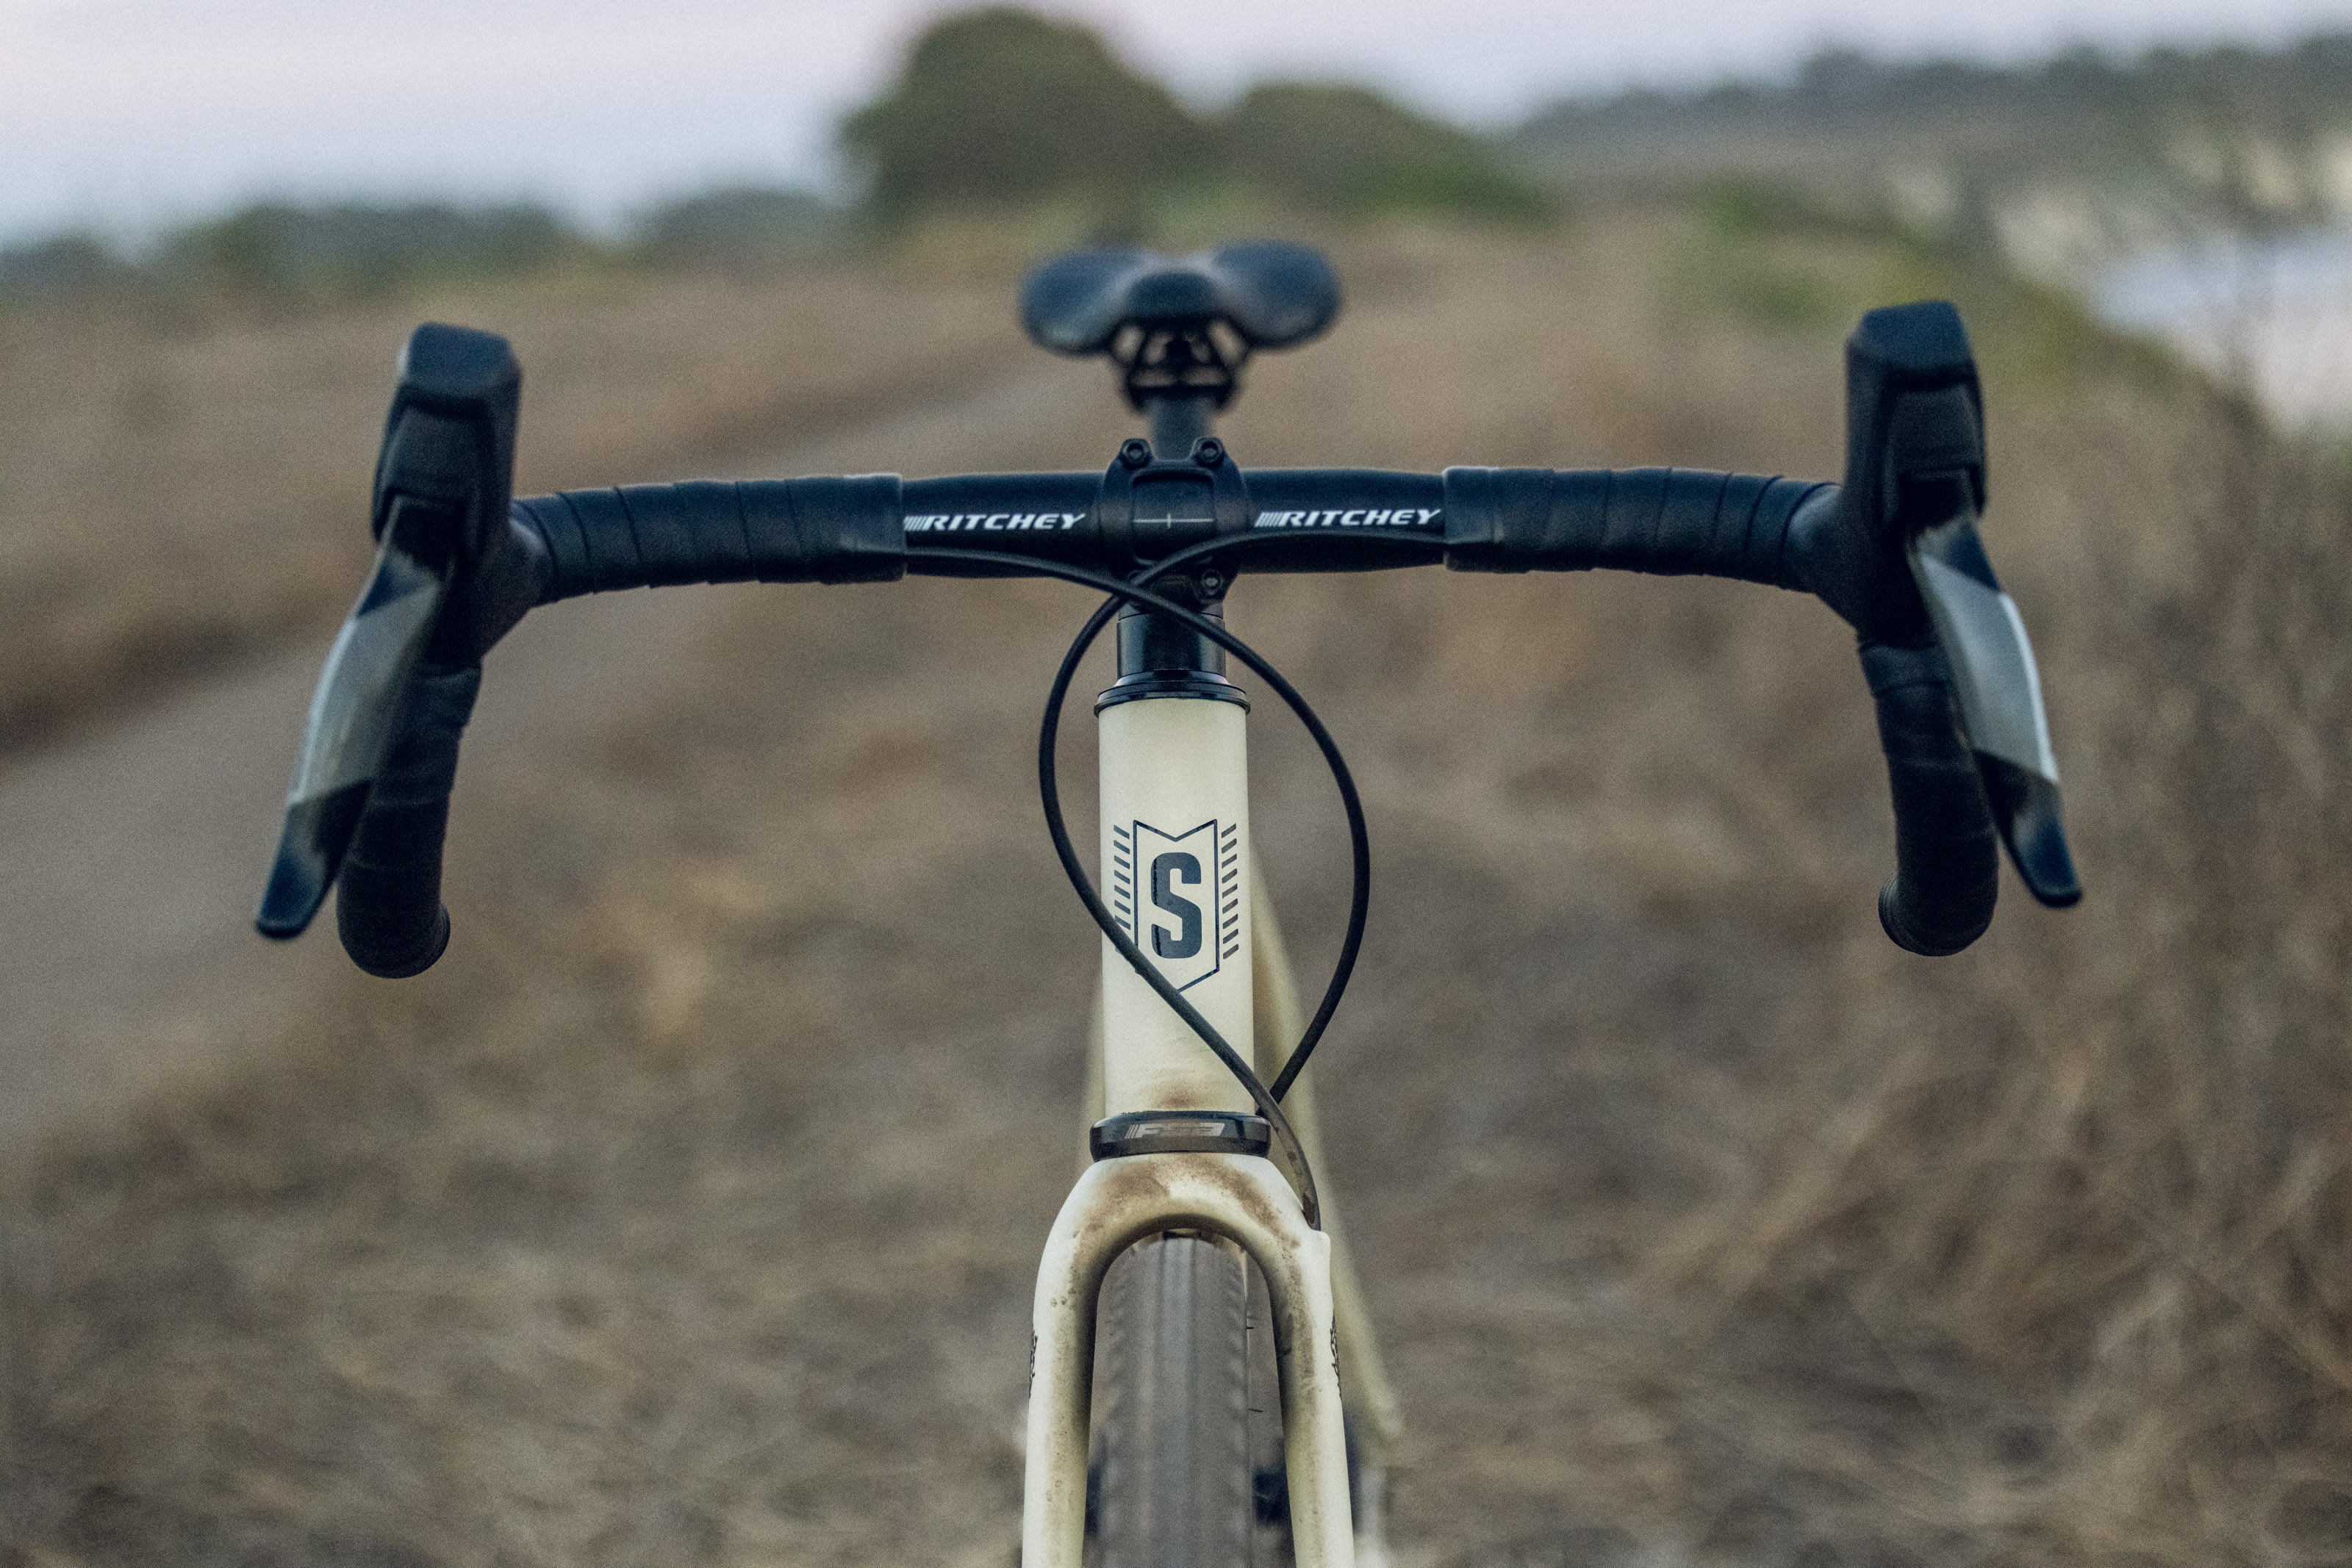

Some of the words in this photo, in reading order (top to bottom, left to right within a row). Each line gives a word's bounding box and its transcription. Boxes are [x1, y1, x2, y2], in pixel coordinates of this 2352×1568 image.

[922, 513, 1086, 531] RITCHEY
[1277, 508, 1441, 527] RITCHEY
[1150, 852, 1202, 959] S
